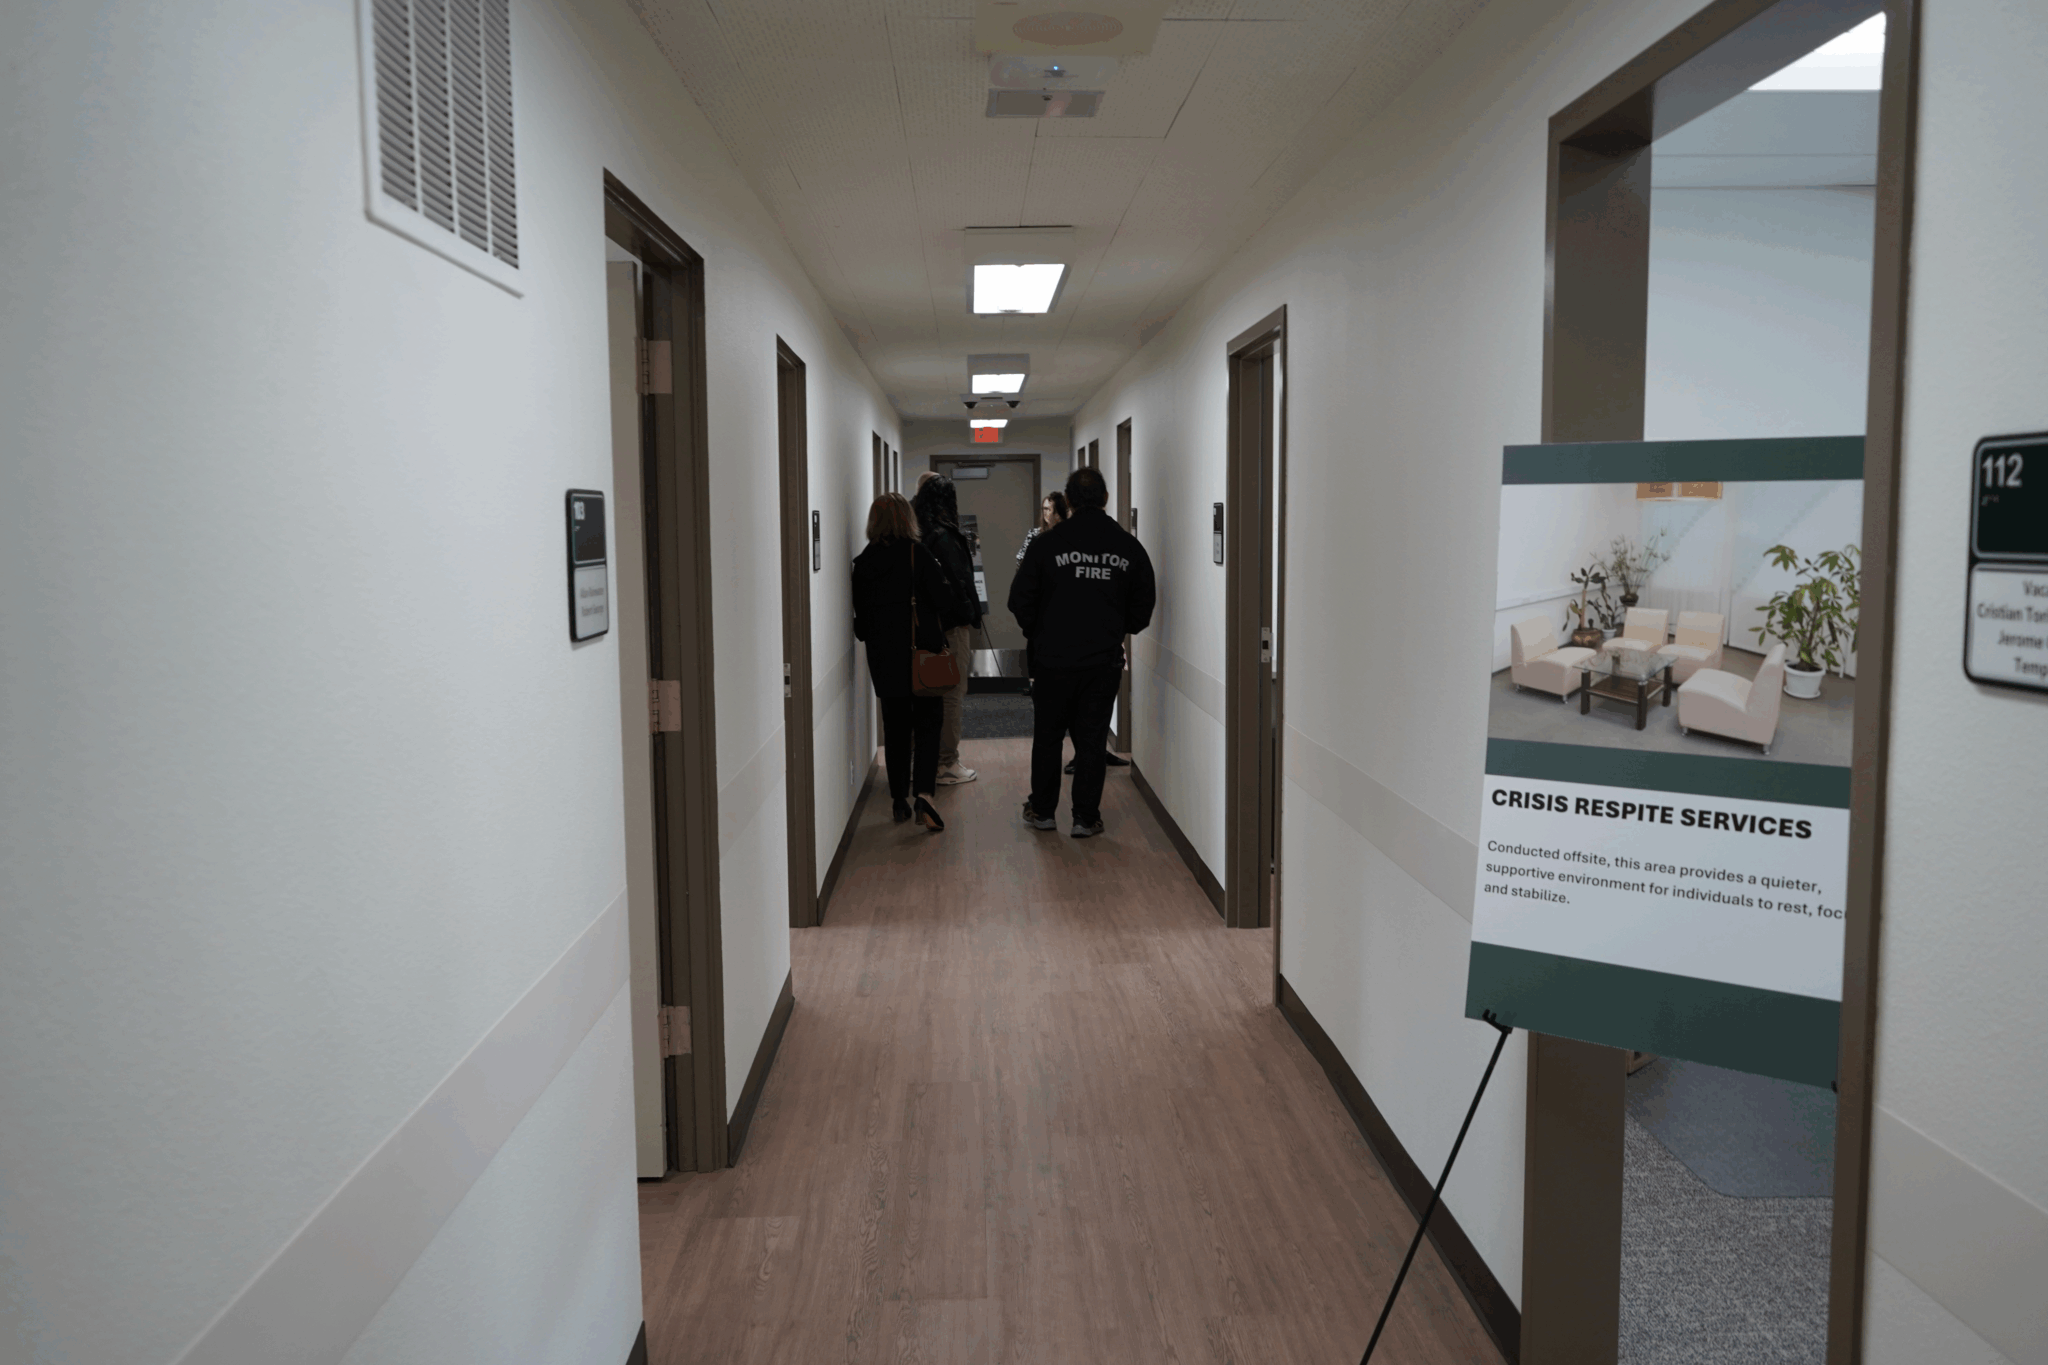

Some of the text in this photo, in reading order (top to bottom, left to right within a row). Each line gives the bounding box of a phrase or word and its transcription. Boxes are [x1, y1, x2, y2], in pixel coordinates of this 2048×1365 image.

[1981, 452, 2024, 488] 112
[1055, 551, 1130, 572] MONITOR
[1075, 566, 1111, 580] FIRE
[1977, 602, 2023, 621] Cristian
[1998, 630, 2043, 649] Jerome
[1491, 789, 1812, 839] CRISIS RESPITE SERVICES
[1487, 840, 1822, 895] Conducted offsite, this area provides a quieter,
[1484, 883, 1571, 904] and stabilize.
[1485, 863, 1555, 881] supportive
[1558, 872, 1646, 893] environment
[1649, 882, 1670, 896] for
[1672, 885, 1754, 908] individuals
[1758, 898, 1773, 910] to
[1777, 901, 1812, 917] rest,
